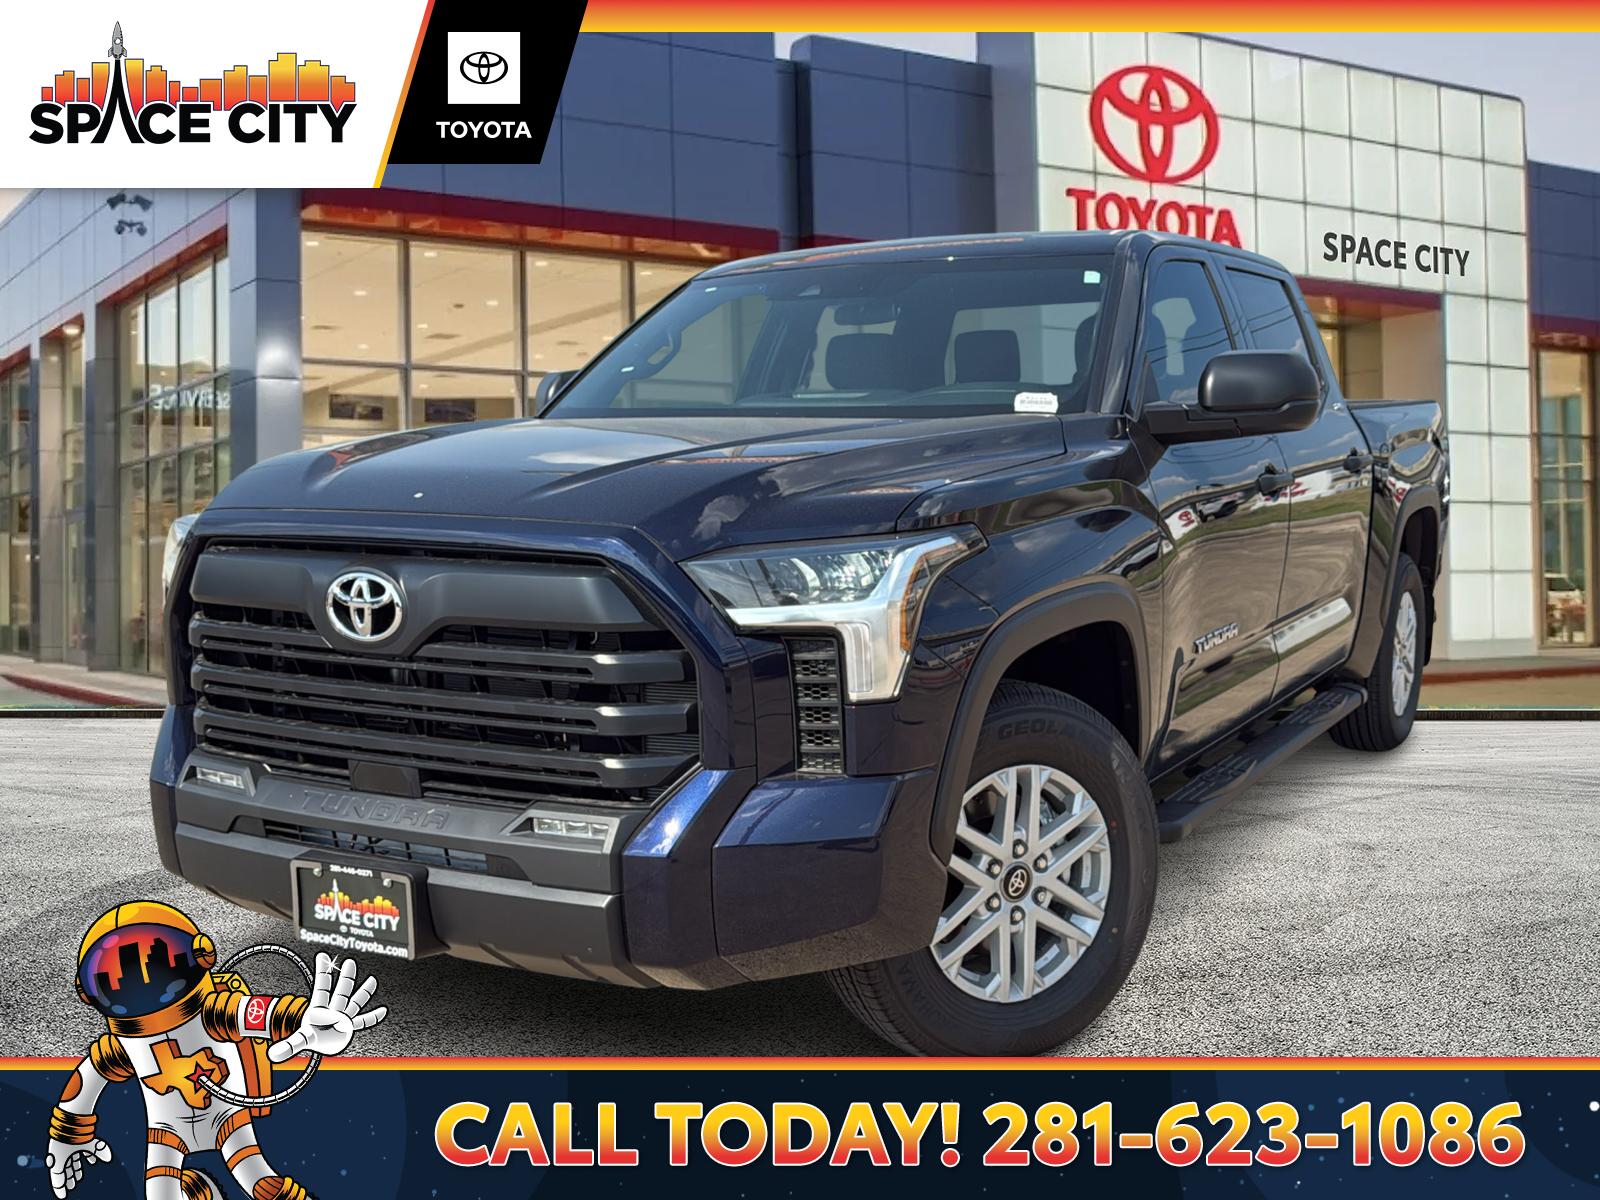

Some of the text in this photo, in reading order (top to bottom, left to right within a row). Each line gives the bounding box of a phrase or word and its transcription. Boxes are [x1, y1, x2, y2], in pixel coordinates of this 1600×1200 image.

[1065, 188, 1242, 249] TOYOTA
[1323, 232, 1470, 276] SPACE CITY
[1192, 622, 1239, 654] TUNDRA
[302, 789, 450, 830] TUNDRA
[314, 899, 400, 932] SPACE CITY
[349, 926, 374, 938] TOYOTA
[300, 928, 409, 958] SpaceCityToyota.com
